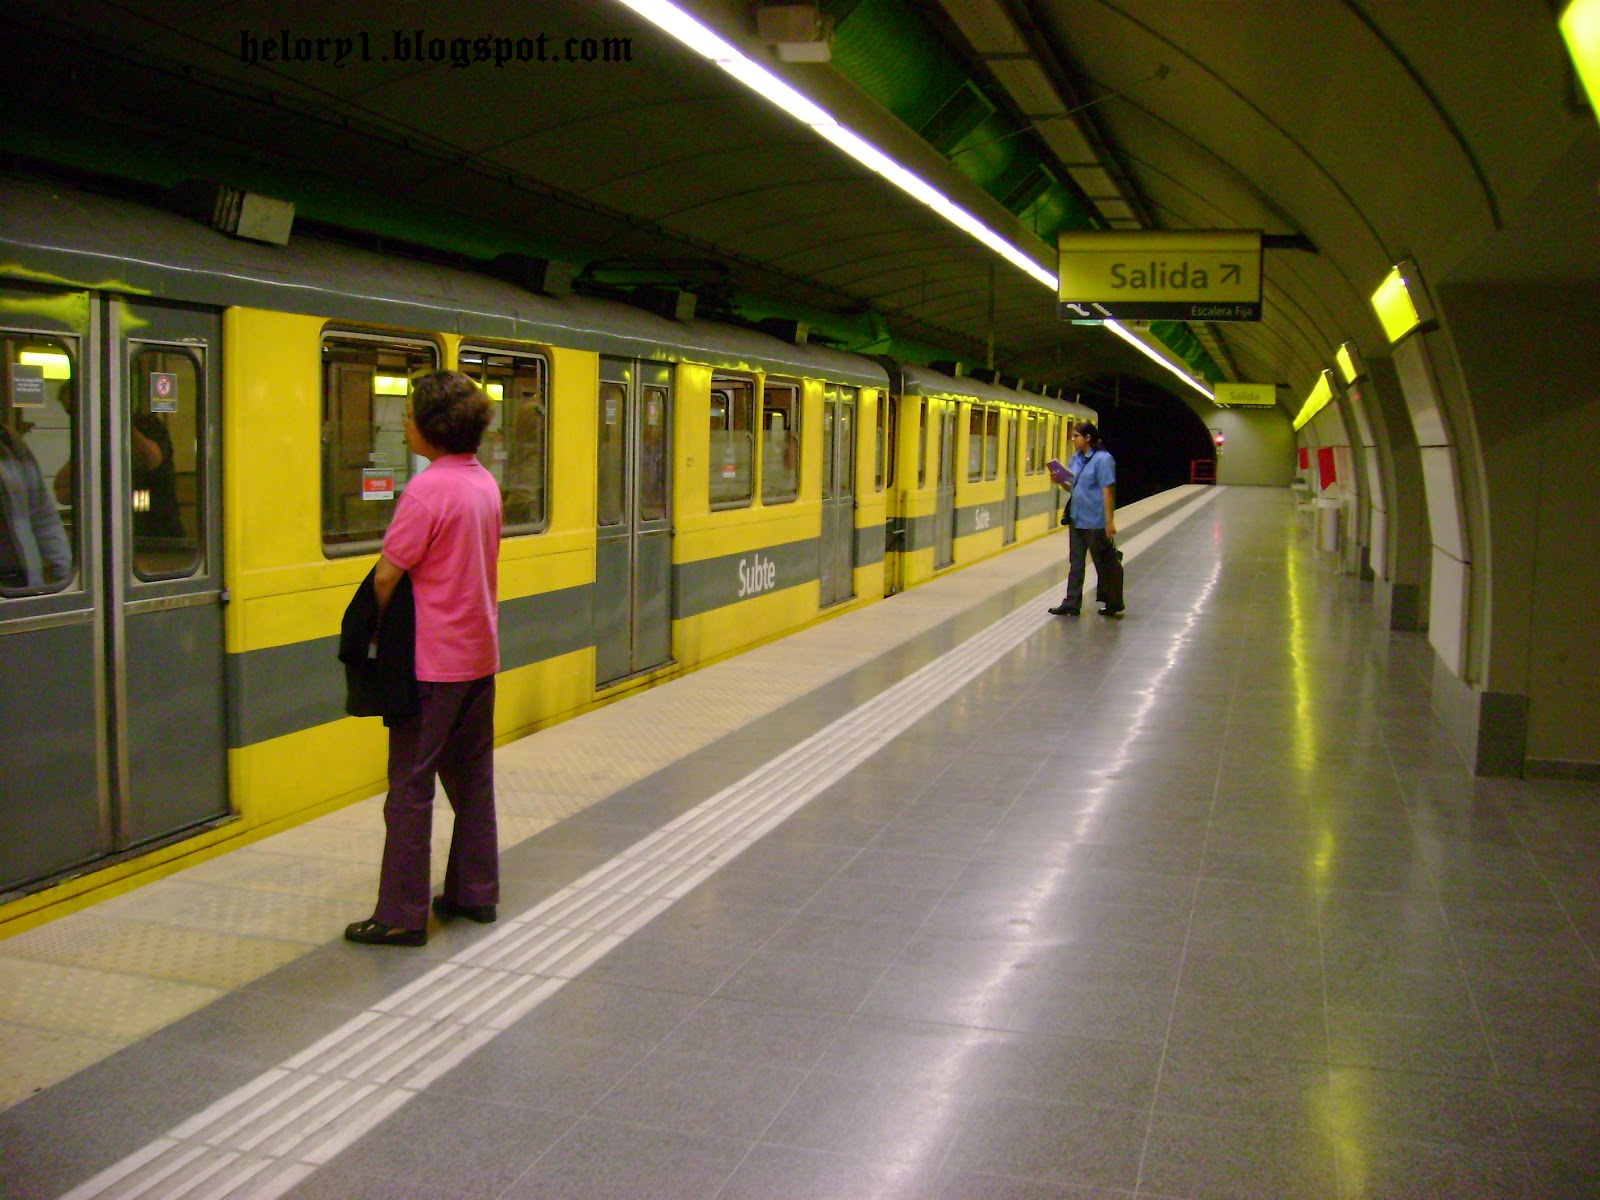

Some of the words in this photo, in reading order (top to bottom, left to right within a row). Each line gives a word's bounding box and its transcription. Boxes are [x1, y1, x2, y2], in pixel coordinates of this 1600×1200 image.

[1111, 262, 1208, 289] Salida
[1191, 305, 1232, 317] Escalera
[1235, 306, 1253, 319] Fija
[1229, 391, 1261, 401] Salida
[738, 554, 776, 597] Subte
